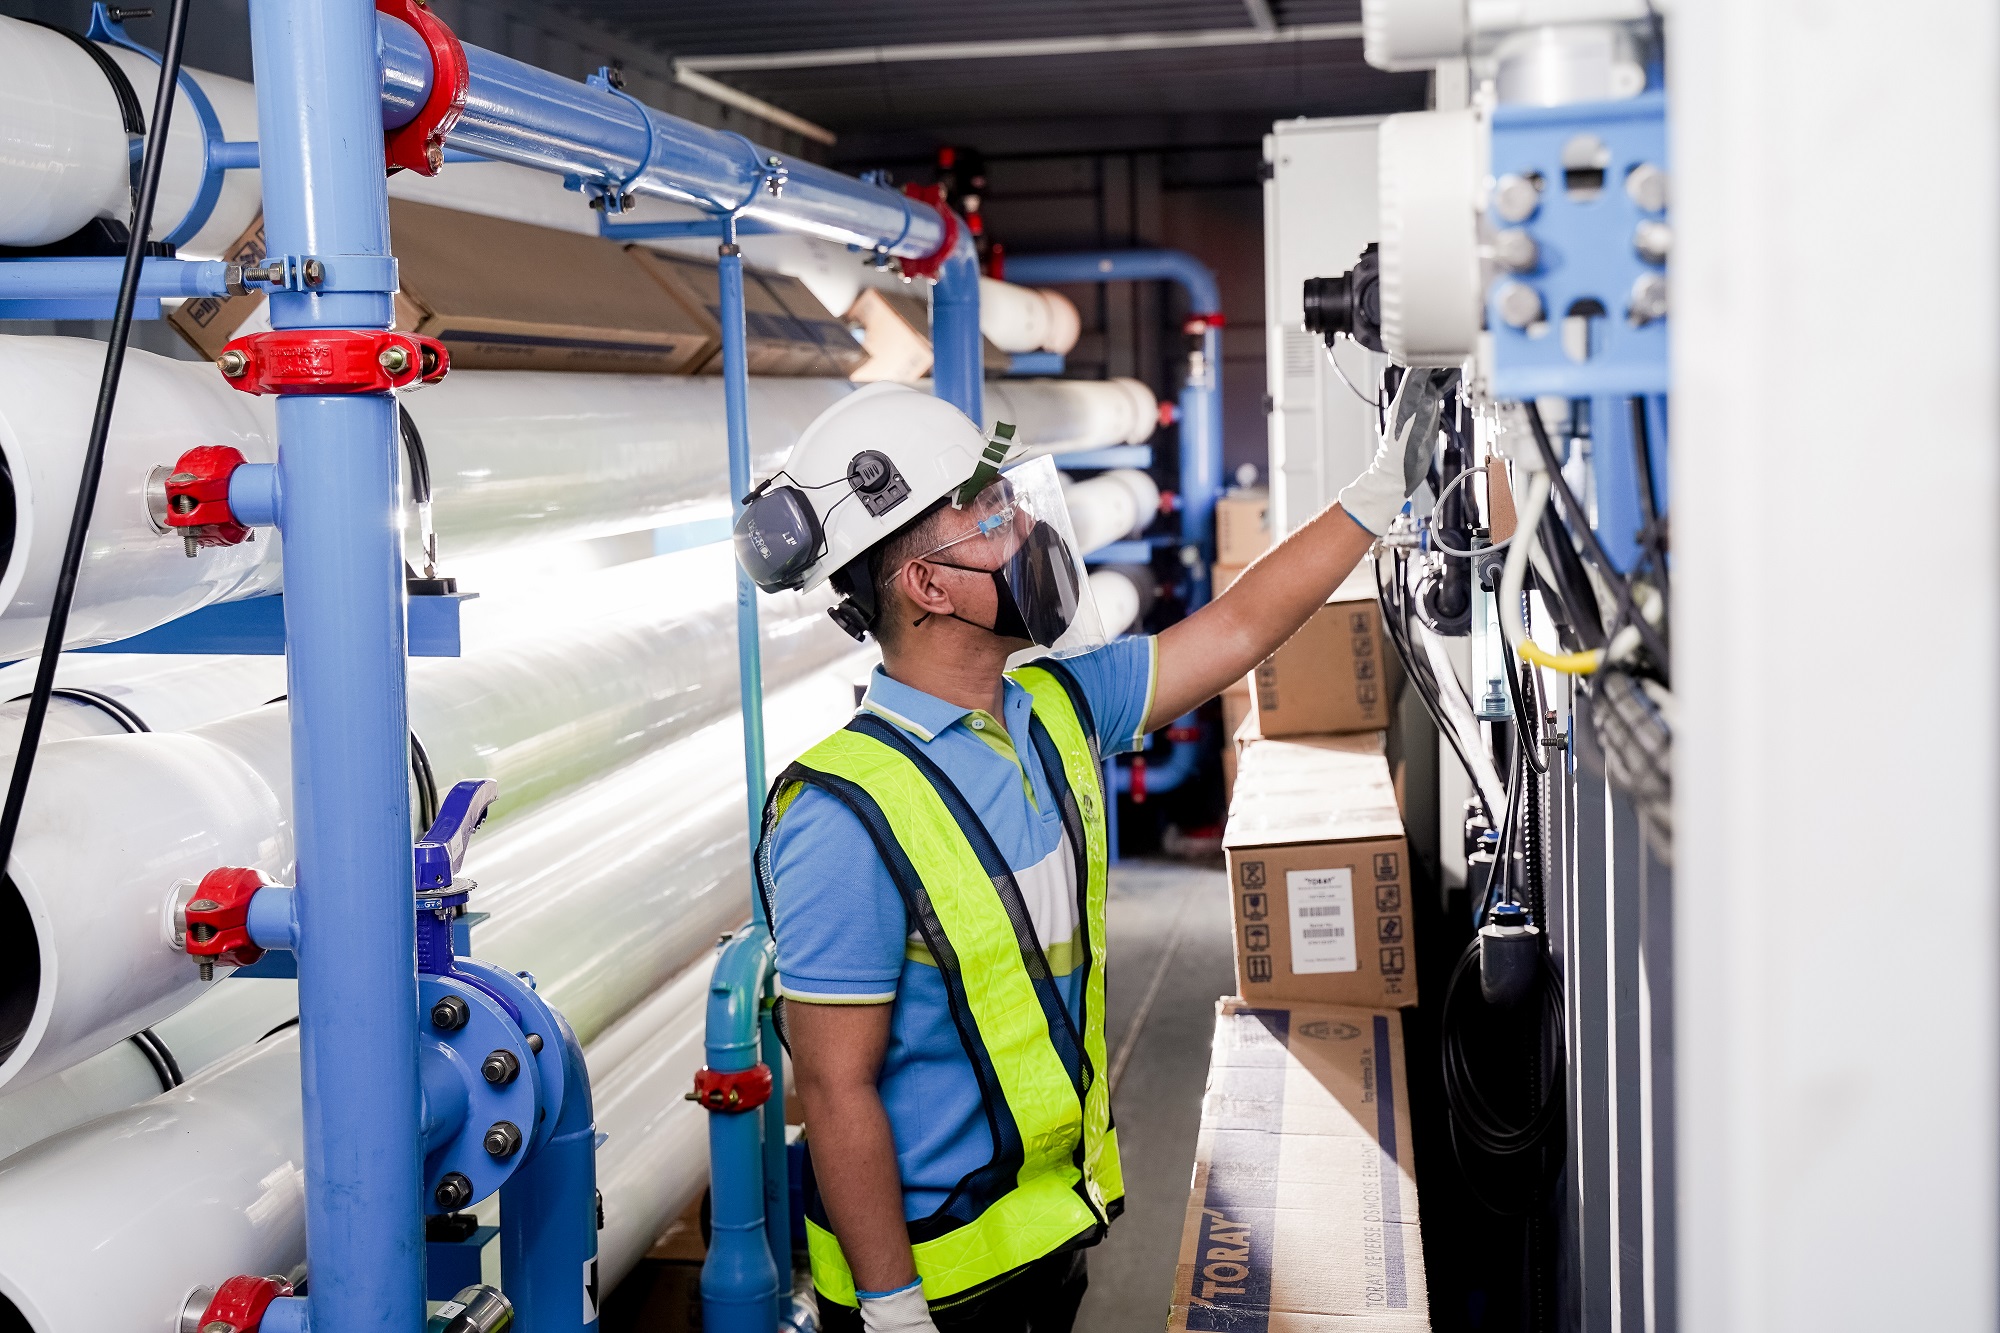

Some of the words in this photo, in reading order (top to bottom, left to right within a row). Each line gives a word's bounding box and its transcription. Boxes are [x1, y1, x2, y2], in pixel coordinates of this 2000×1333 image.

[1362, 1182, 1381, 1222] OSMOSIS
[1364, 1227, 1383, 1267] REVERSE
[1365, 1272, 1384, 1307] TORAY
